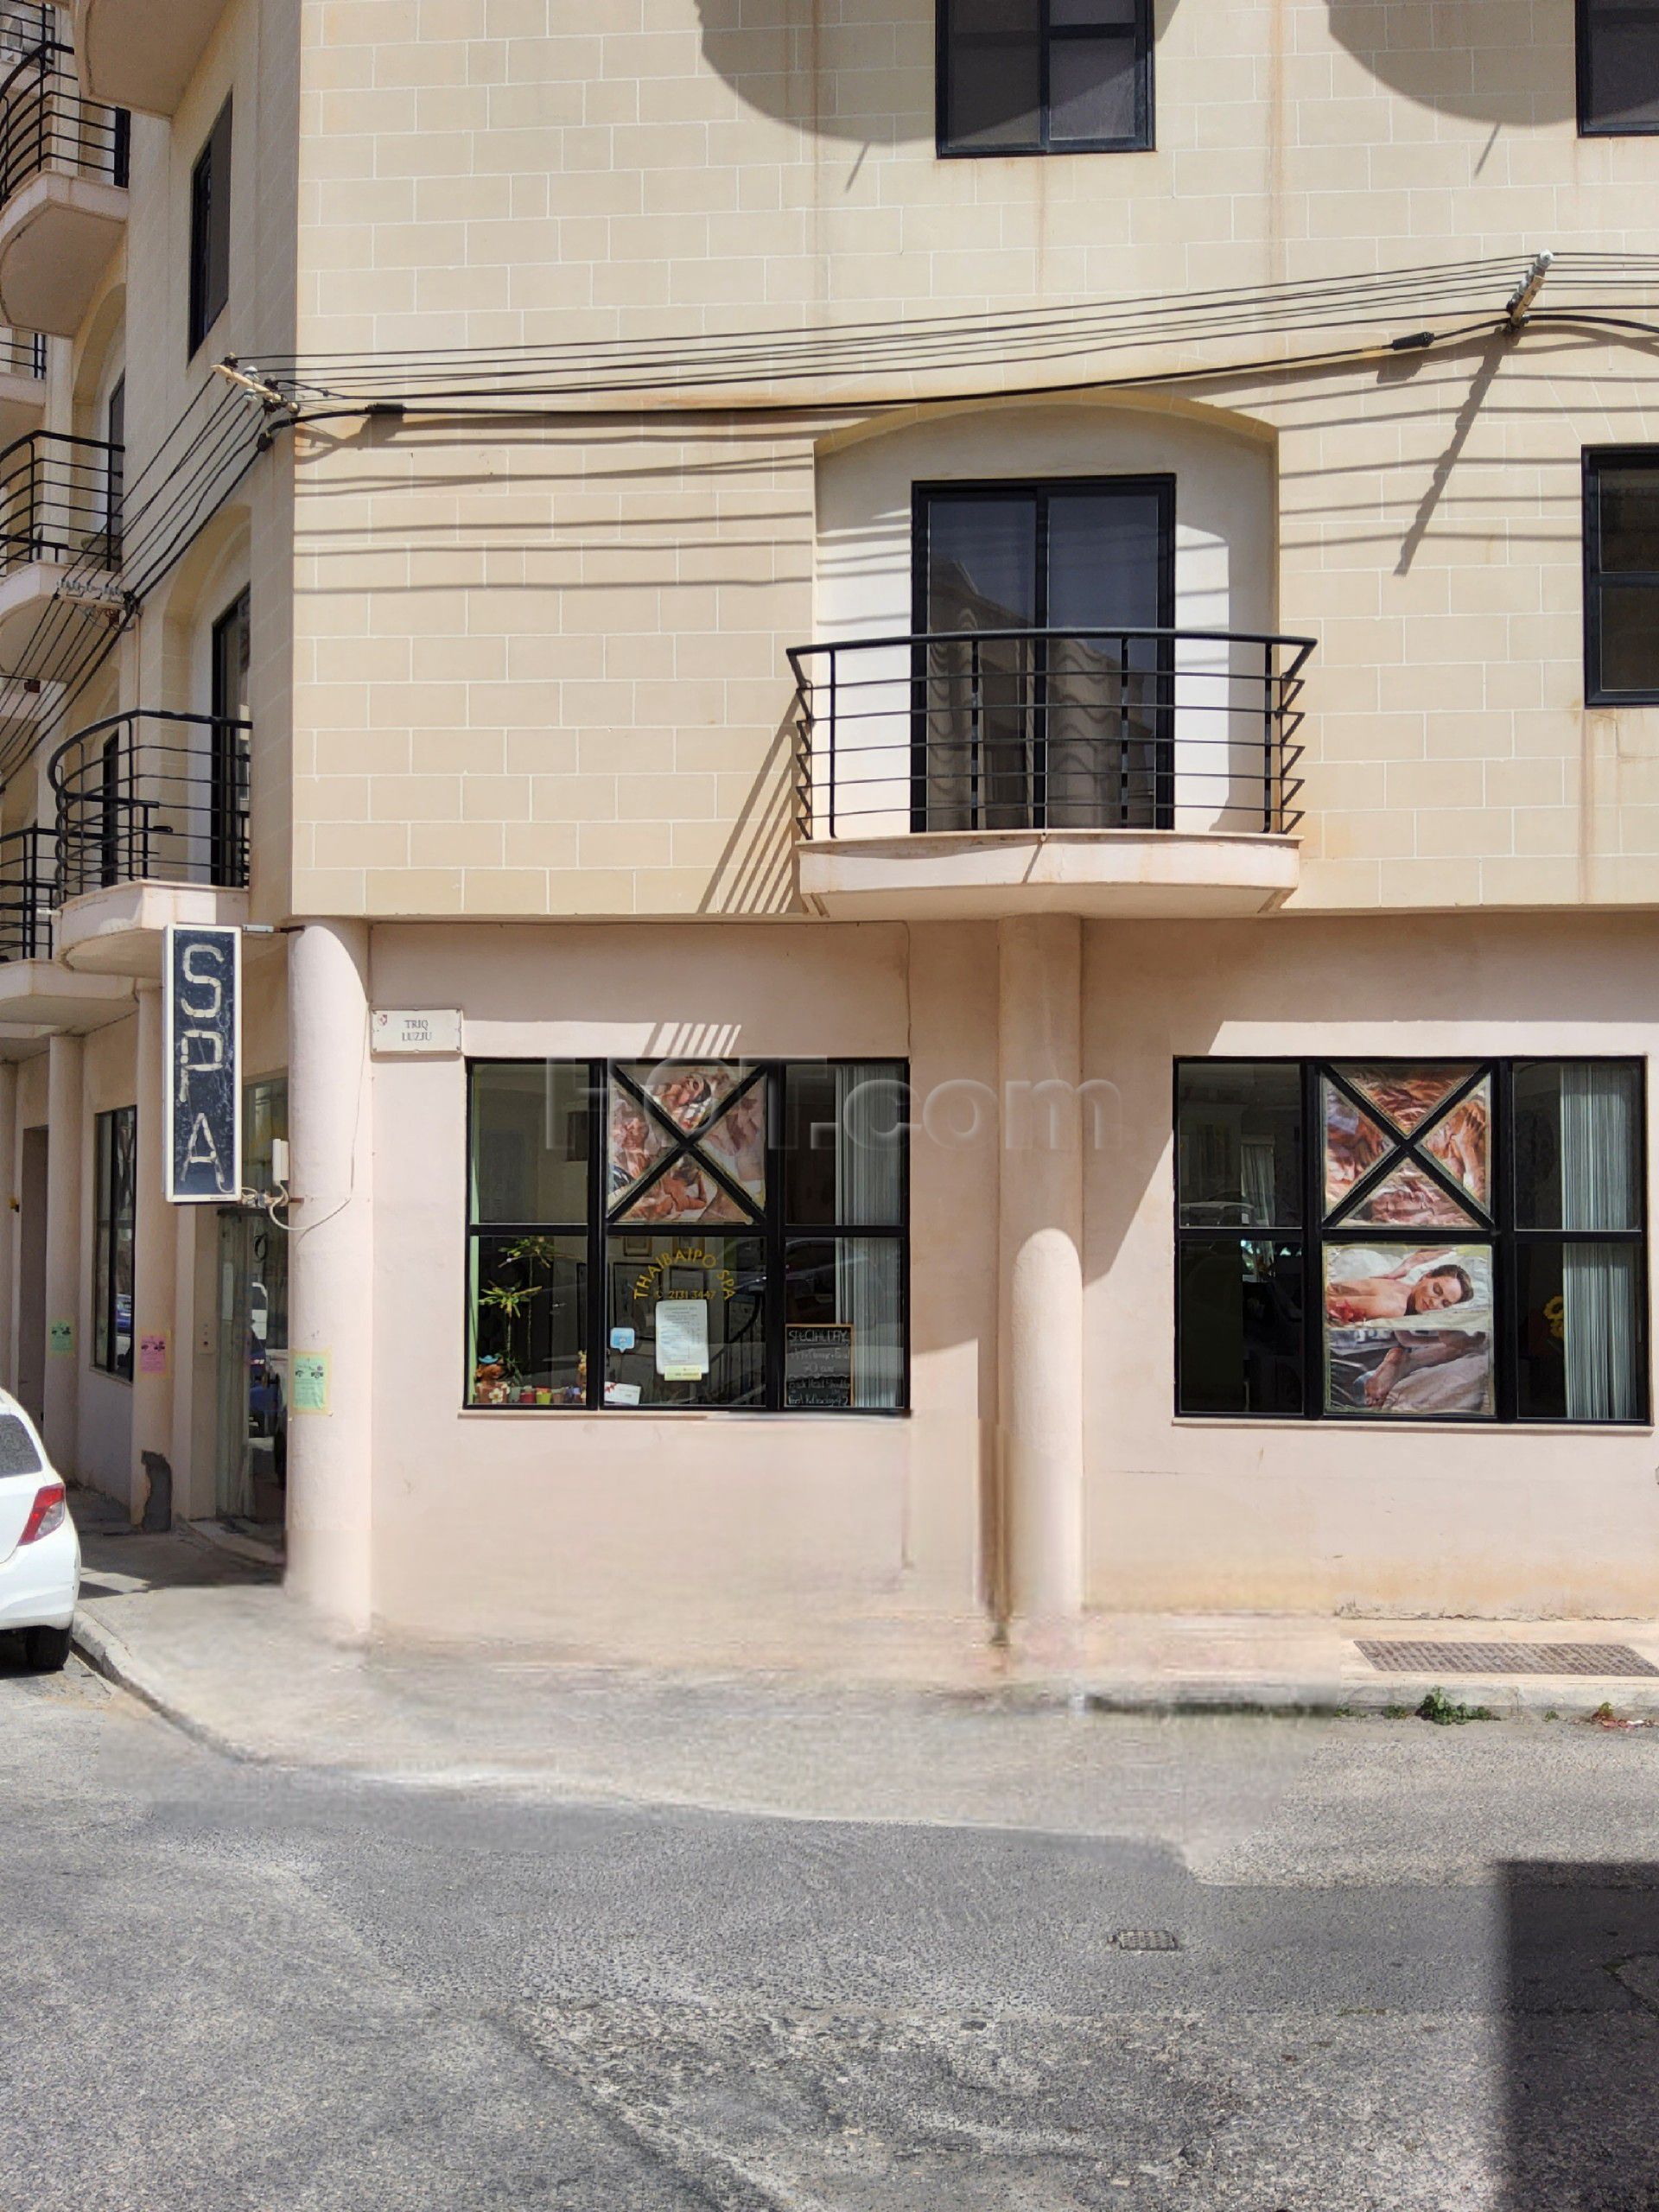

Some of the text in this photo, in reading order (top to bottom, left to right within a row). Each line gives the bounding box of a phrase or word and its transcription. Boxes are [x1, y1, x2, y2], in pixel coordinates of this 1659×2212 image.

[404, 1020, 429, 1031] TRIQ
[180, 944, 224, 1183] SPA
[716, 1268, 736, 1300] SPA
